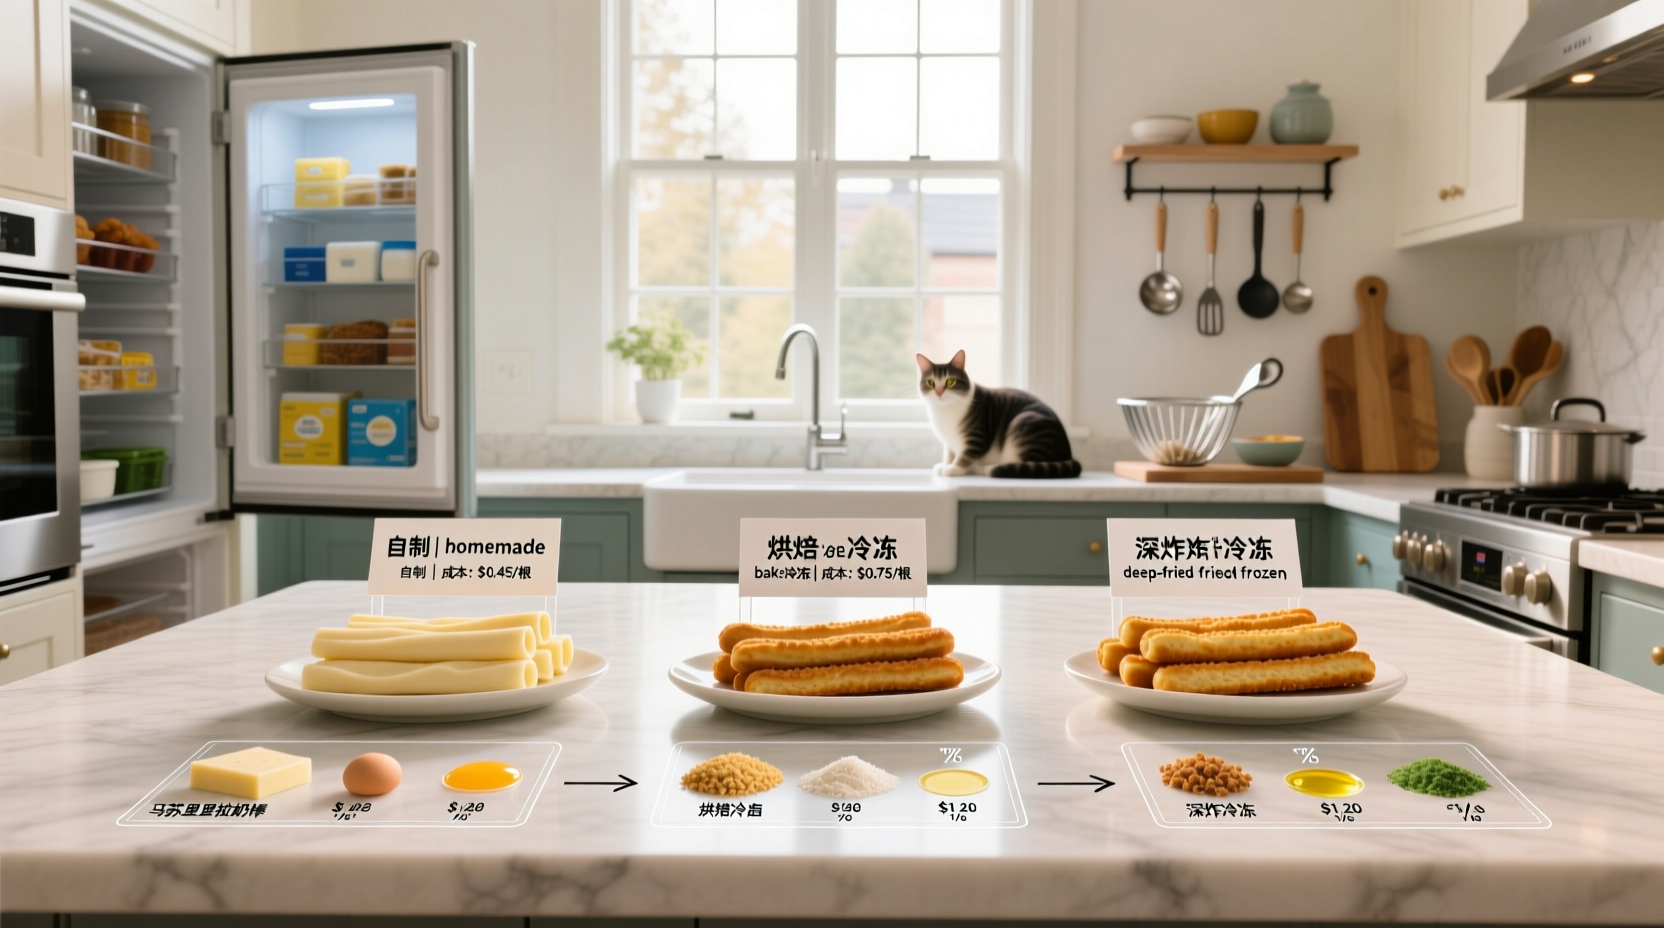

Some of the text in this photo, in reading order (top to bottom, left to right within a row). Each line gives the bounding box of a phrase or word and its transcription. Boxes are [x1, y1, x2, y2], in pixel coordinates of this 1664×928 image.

[388, 535, 545, 558] 自制 homemade
[401, 565, 426, 579] 自制
[478, 565, 531, 579] $0.45/根
[857, 566, 912, 580] $0.75/根
[1124, 565, 1194, 582] deep-fried
[1241, 566, 1287, 580] frozen
